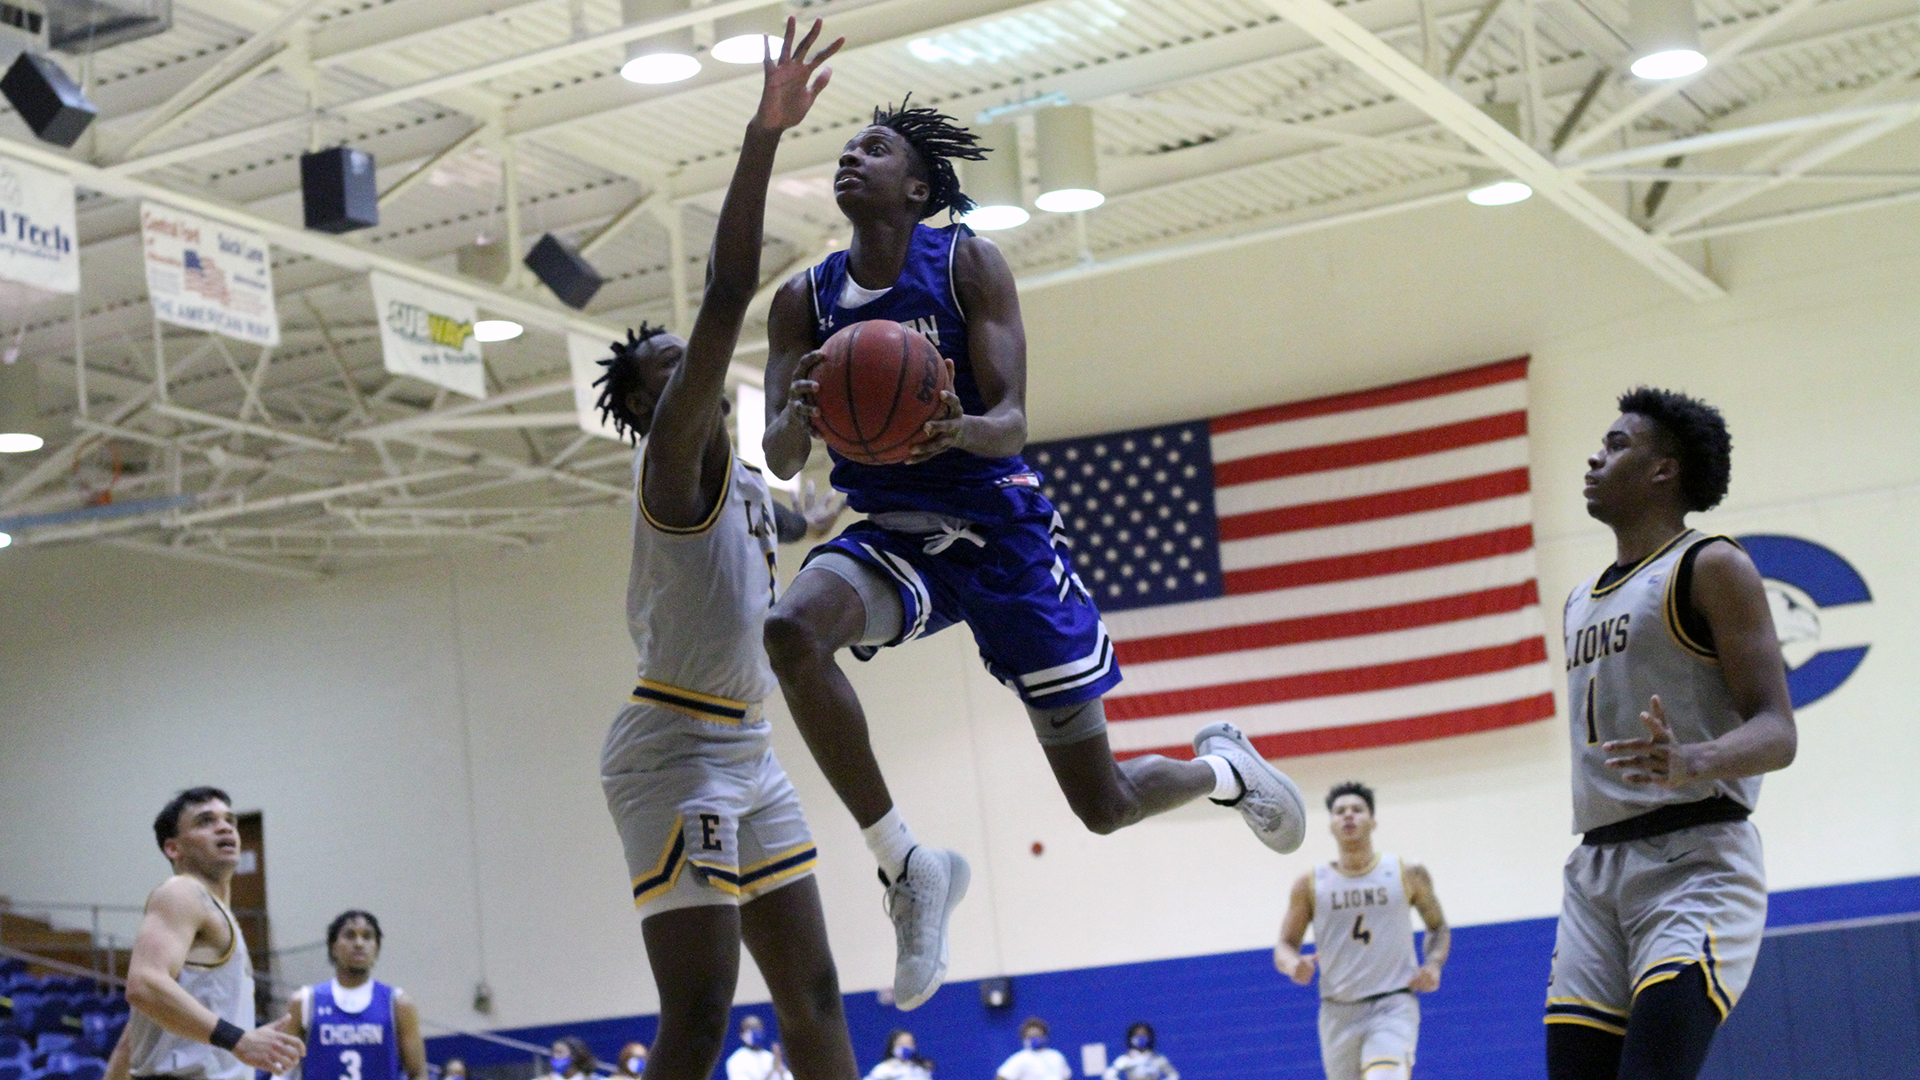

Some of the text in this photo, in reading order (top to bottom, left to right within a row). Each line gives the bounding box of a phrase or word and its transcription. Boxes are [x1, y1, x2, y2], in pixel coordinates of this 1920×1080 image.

[12, 212, 71, 255] Tech
[386, 300, 475, 351] SUBWAY
[1586, 676, 1599, 745] 1
[699, 813, 722, 851] E
[1331, 887, 1388, 910] LIONS
[1352, 914, 1371, 945] 4
[320, 1024, 384, 1046] CHOWAN
[338, 1050, 363, 1080] 3
